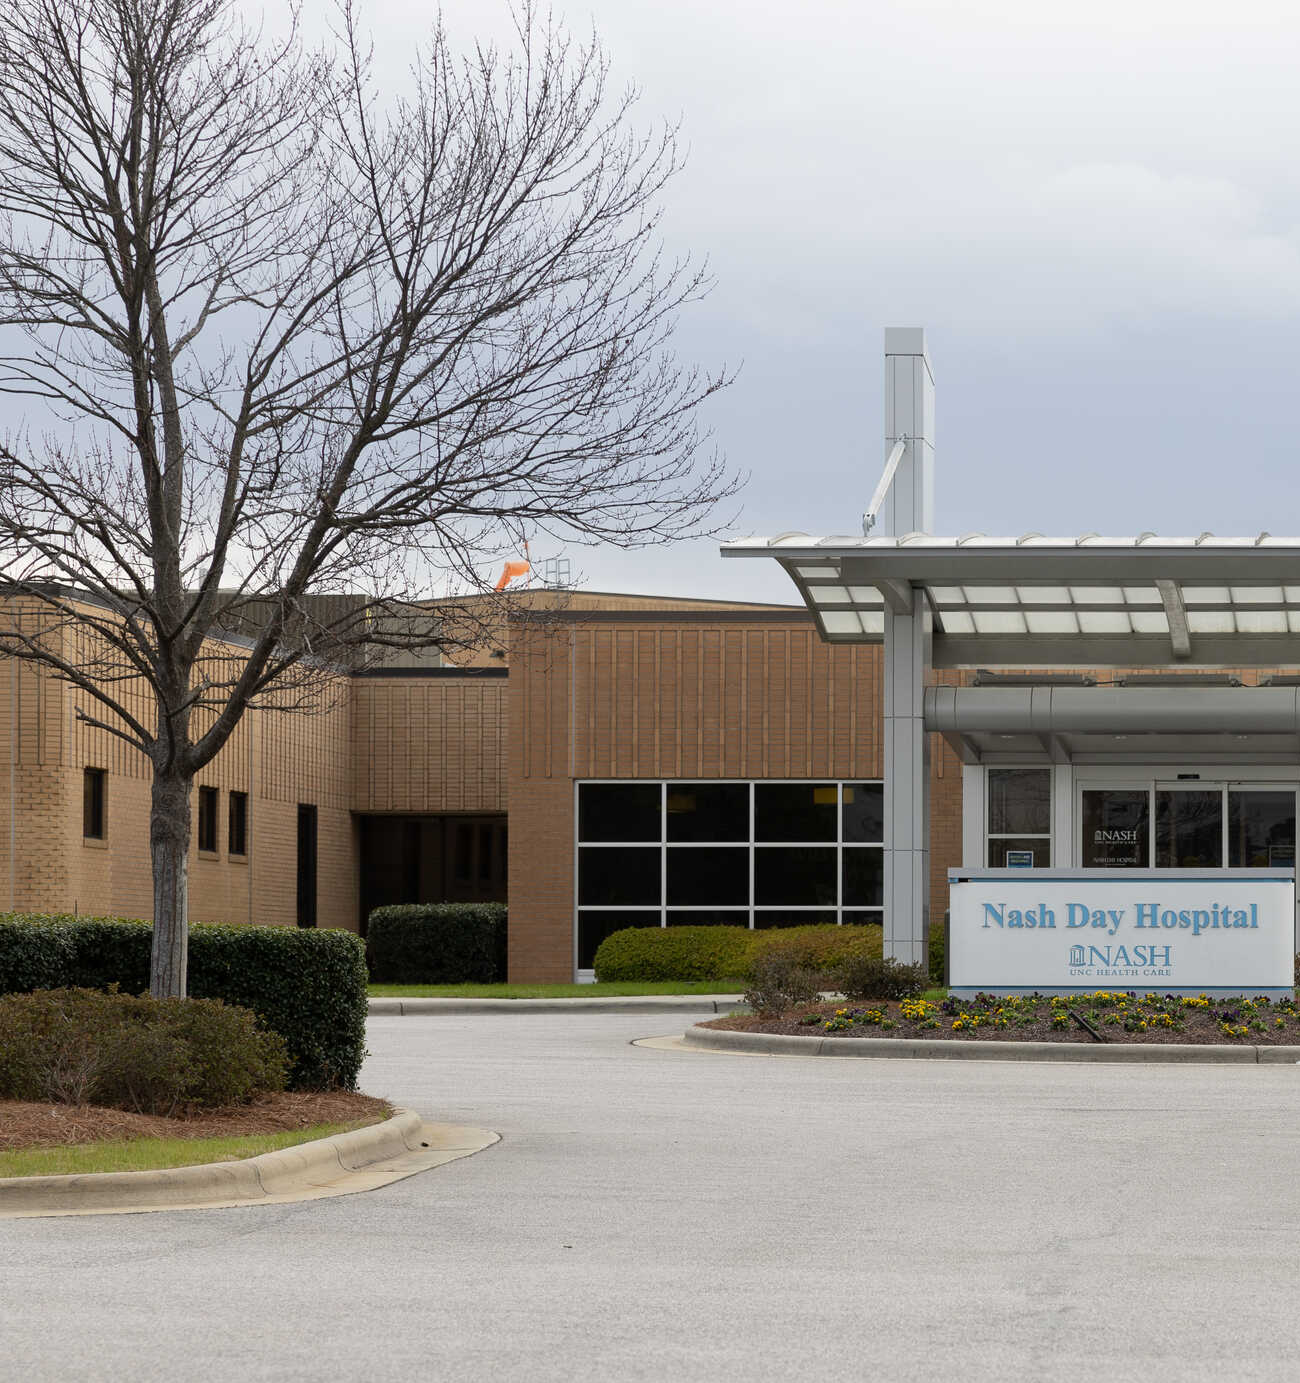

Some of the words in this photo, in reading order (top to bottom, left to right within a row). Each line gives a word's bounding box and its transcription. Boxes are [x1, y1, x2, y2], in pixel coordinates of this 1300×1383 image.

[1102, 830, 1137, 841] NASH
[982, 903, 1056, 929] Nash
[1065, 903, 1125, 935] Day
[1134, 903, 1259, 935] Hospital
[1088, 945, 1172, 967] NASH
[1070, 969, 1092, 977] UNC
[1096, 969, 1138, 977] HEALTH
[1143, 969, 1171, 977] CARE
